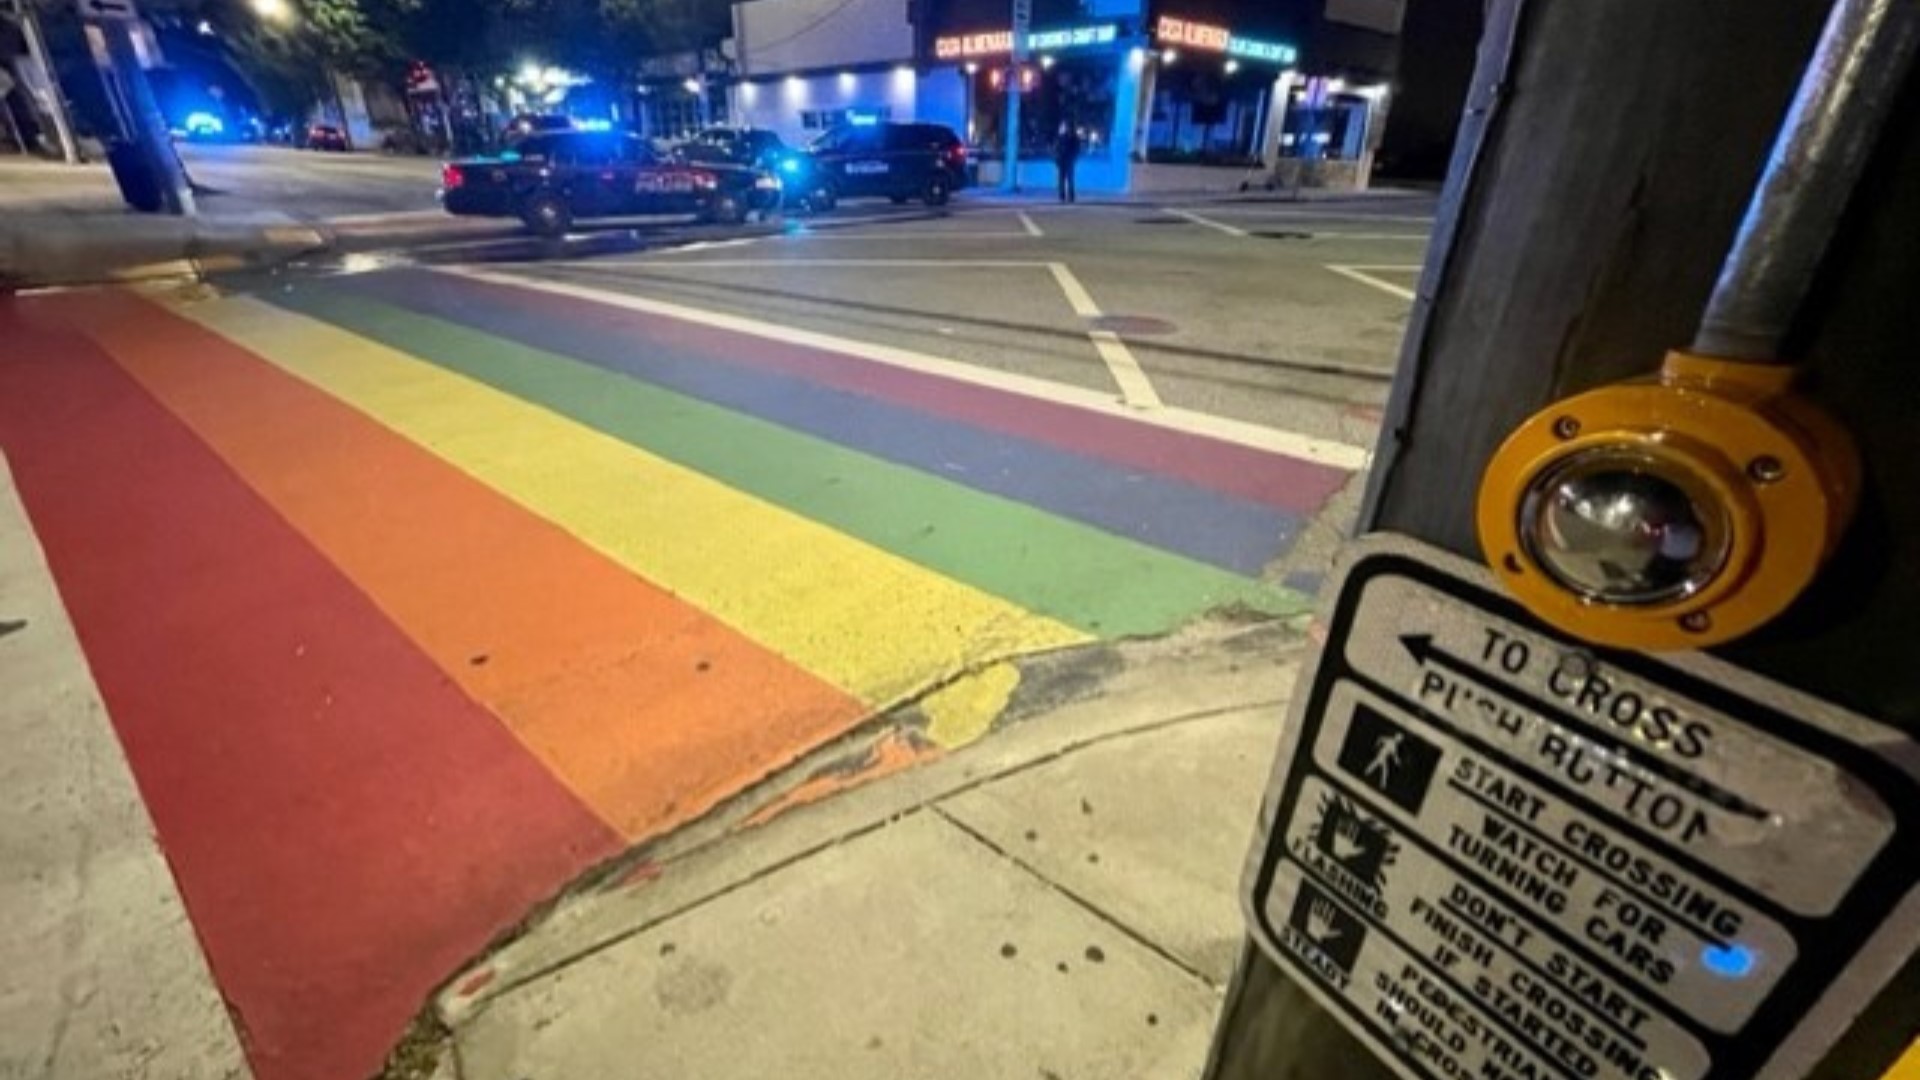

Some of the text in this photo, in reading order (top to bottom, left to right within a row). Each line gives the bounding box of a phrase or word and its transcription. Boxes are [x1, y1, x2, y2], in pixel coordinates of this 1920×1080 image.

[1482, 627, 1713, 759] TO CROSS
[1293, 836, 1389, 919] FLASHING
[1450, 824, 1675, 985] TURNING CARS
[1455, 757, 1743, 937] START CROSSING
[1484, 815, 1667, 945] WATCH FOR
[1410, 897, 1496, 968] FINISH
[1451, 883, 1651, 1032] DON'T START
[1374, 970, 1466, 1053] SHOULD
[1401, 963, 1551, 1080] PEDESTRIA
[1433, 945, 1599, 1078] IF STARTED
